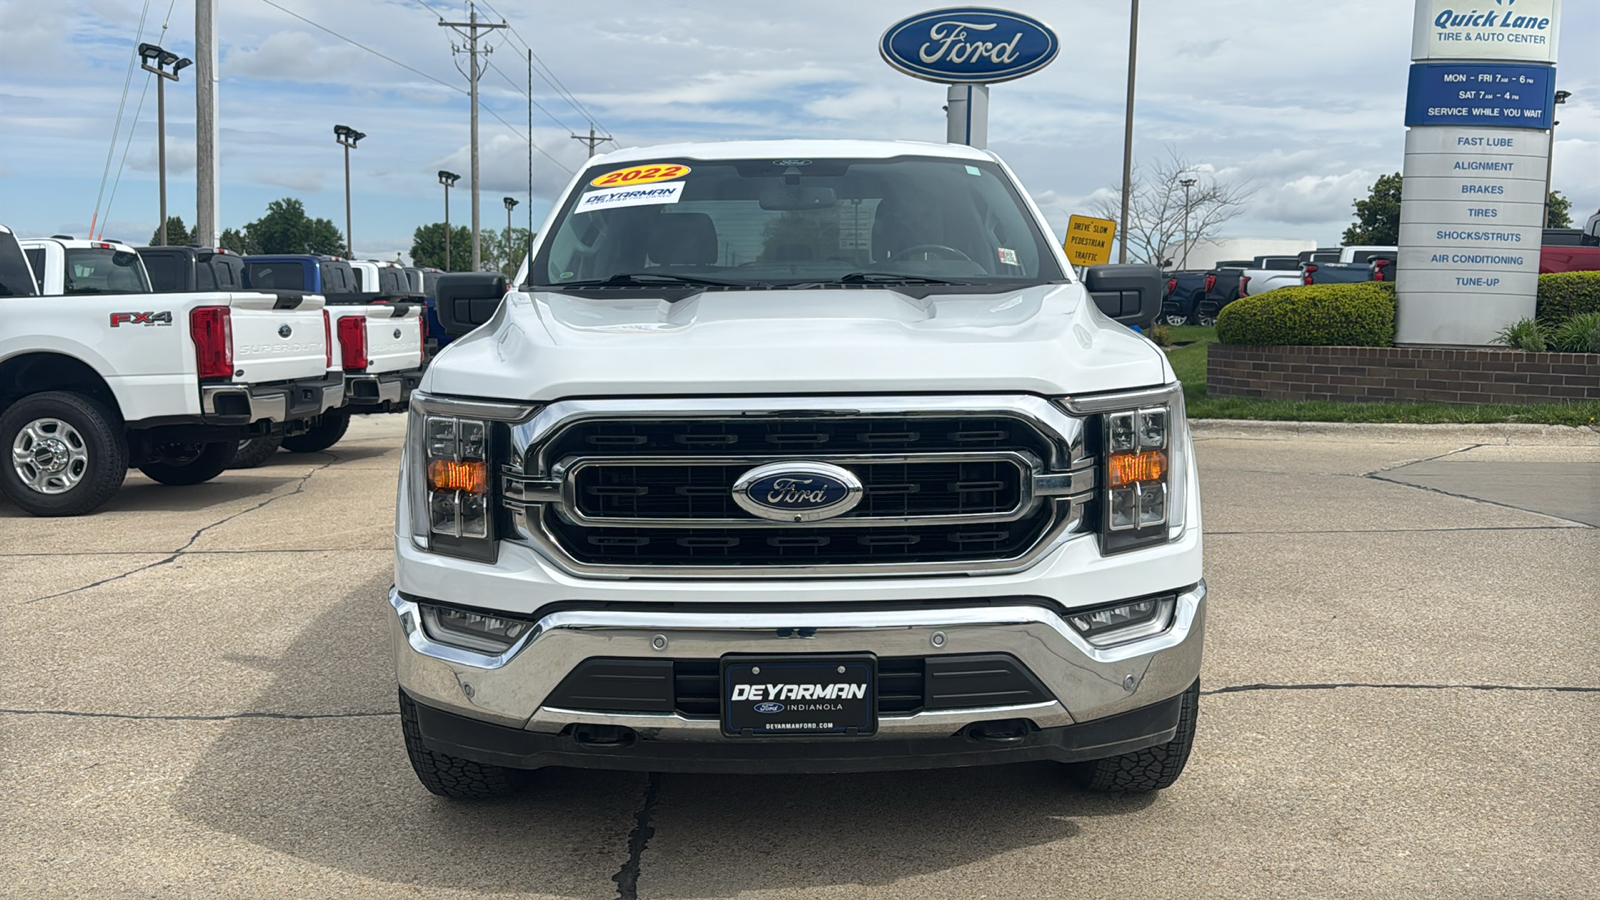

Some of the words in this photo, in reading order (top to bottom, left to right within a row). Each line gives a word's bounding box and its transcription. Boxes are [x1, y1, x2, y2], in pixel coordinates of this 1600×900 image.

[1434, 9, 1499, 29] Quick
[1499, 11, 1550, 30] Lane
[919, 21, 1023, 64] Ford
[1437, 32, 1462, 41] TIRE
[1465, 33, 1472, 41] &
[1475, 33, 1504, 42] AUTO
[1507, 34, 1546, 44] CENTER
[1443, 74, 1466, 82] MON
[1478, 74, 1493, 82] FRI
[1459, 91, 1476, 99] SAT
[1428, 107, 1469, 116] SERVICE
[1472, 108, 1500, 116] WHILE
[1503, 109, 1521, 117] YOU
[1523, 109, 1542, 118] WAIT
[1457, 137, 1484, 146] FAST
[1486, 138, 1514, 147] LUBE
[1453, 161, 1514, 171] ALIGNMENT
[599, 166, 683, 186] 2022
[1461, 185, 1504, 194] BRAKES
[585, 188, 677, 204] DEYARMAN
[1467, 208, 1498, 217] TIRES
[1073, 222, 1091, 232] DRIVE
[1093, 225, 1109, 234] SLOW
[1070, 236, 1106, 248] PEDESTRIAN
[1436, 230, 1522, 242] SHOCKS/STRUTS
[1075, 251, 1098, 262] TRAFFIC
[1431, 254, 1449, 263] AIR
[1451, 255, 1524, 265] CONDITIONING
[1455, 277, 1500, 287] TUNE-UP
[110, 311, 172, 327] FX4
[239, 343, 290, 355] SUPER
[292, 342, 323, 352] DUTY
[767, 478, 828, 504] Ford
[731, 684, 867, 701] DEYARMAN
[759, 703, 779, 712] Ford
[787, 703, 843, 711] INDIANOLA
